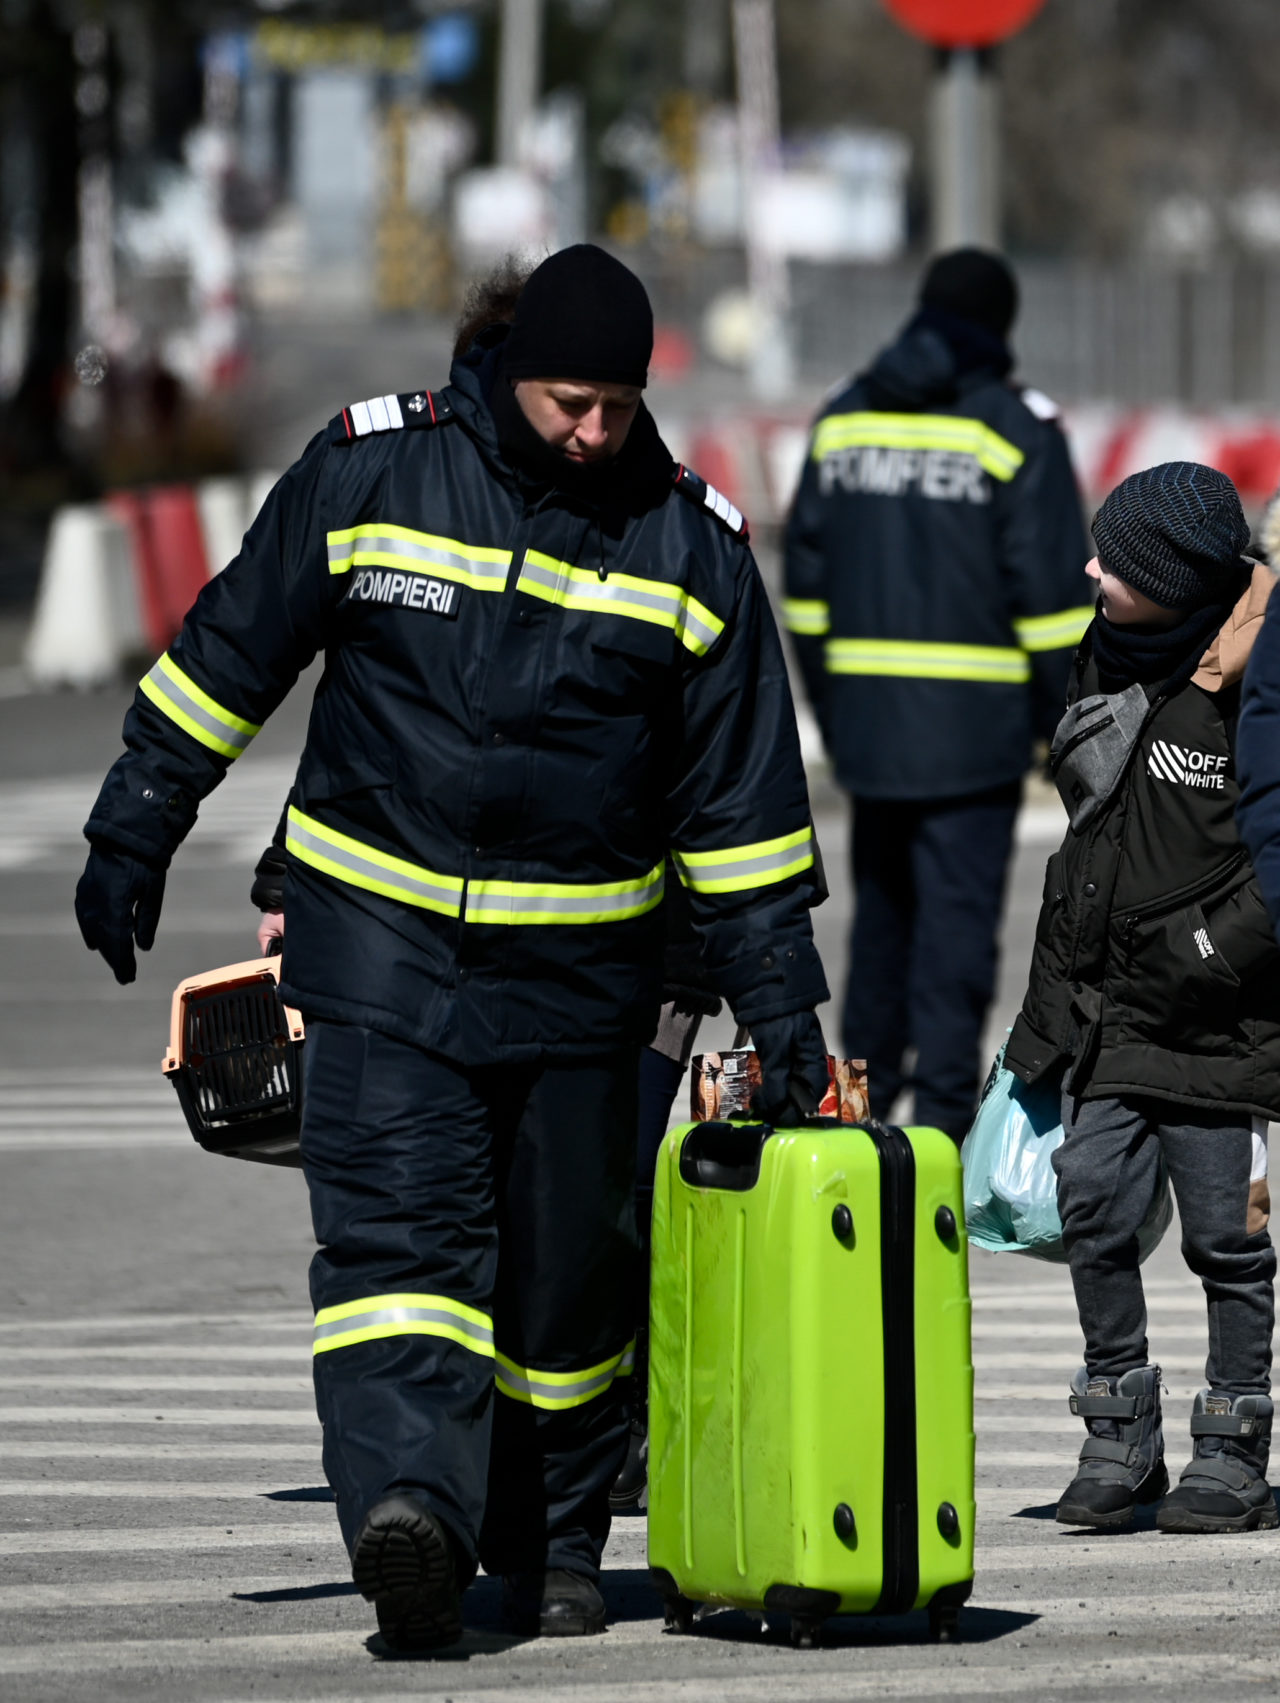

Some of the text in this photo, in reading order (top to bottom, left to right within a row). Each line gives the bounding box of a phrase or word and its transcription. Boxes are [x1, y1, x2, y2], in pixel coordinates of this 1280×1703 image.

[349, 570, 455, 614] POMPIERII
[1188, 751, 1229, 772] OFF
[1185, 771, 1224, 789] WHITE
